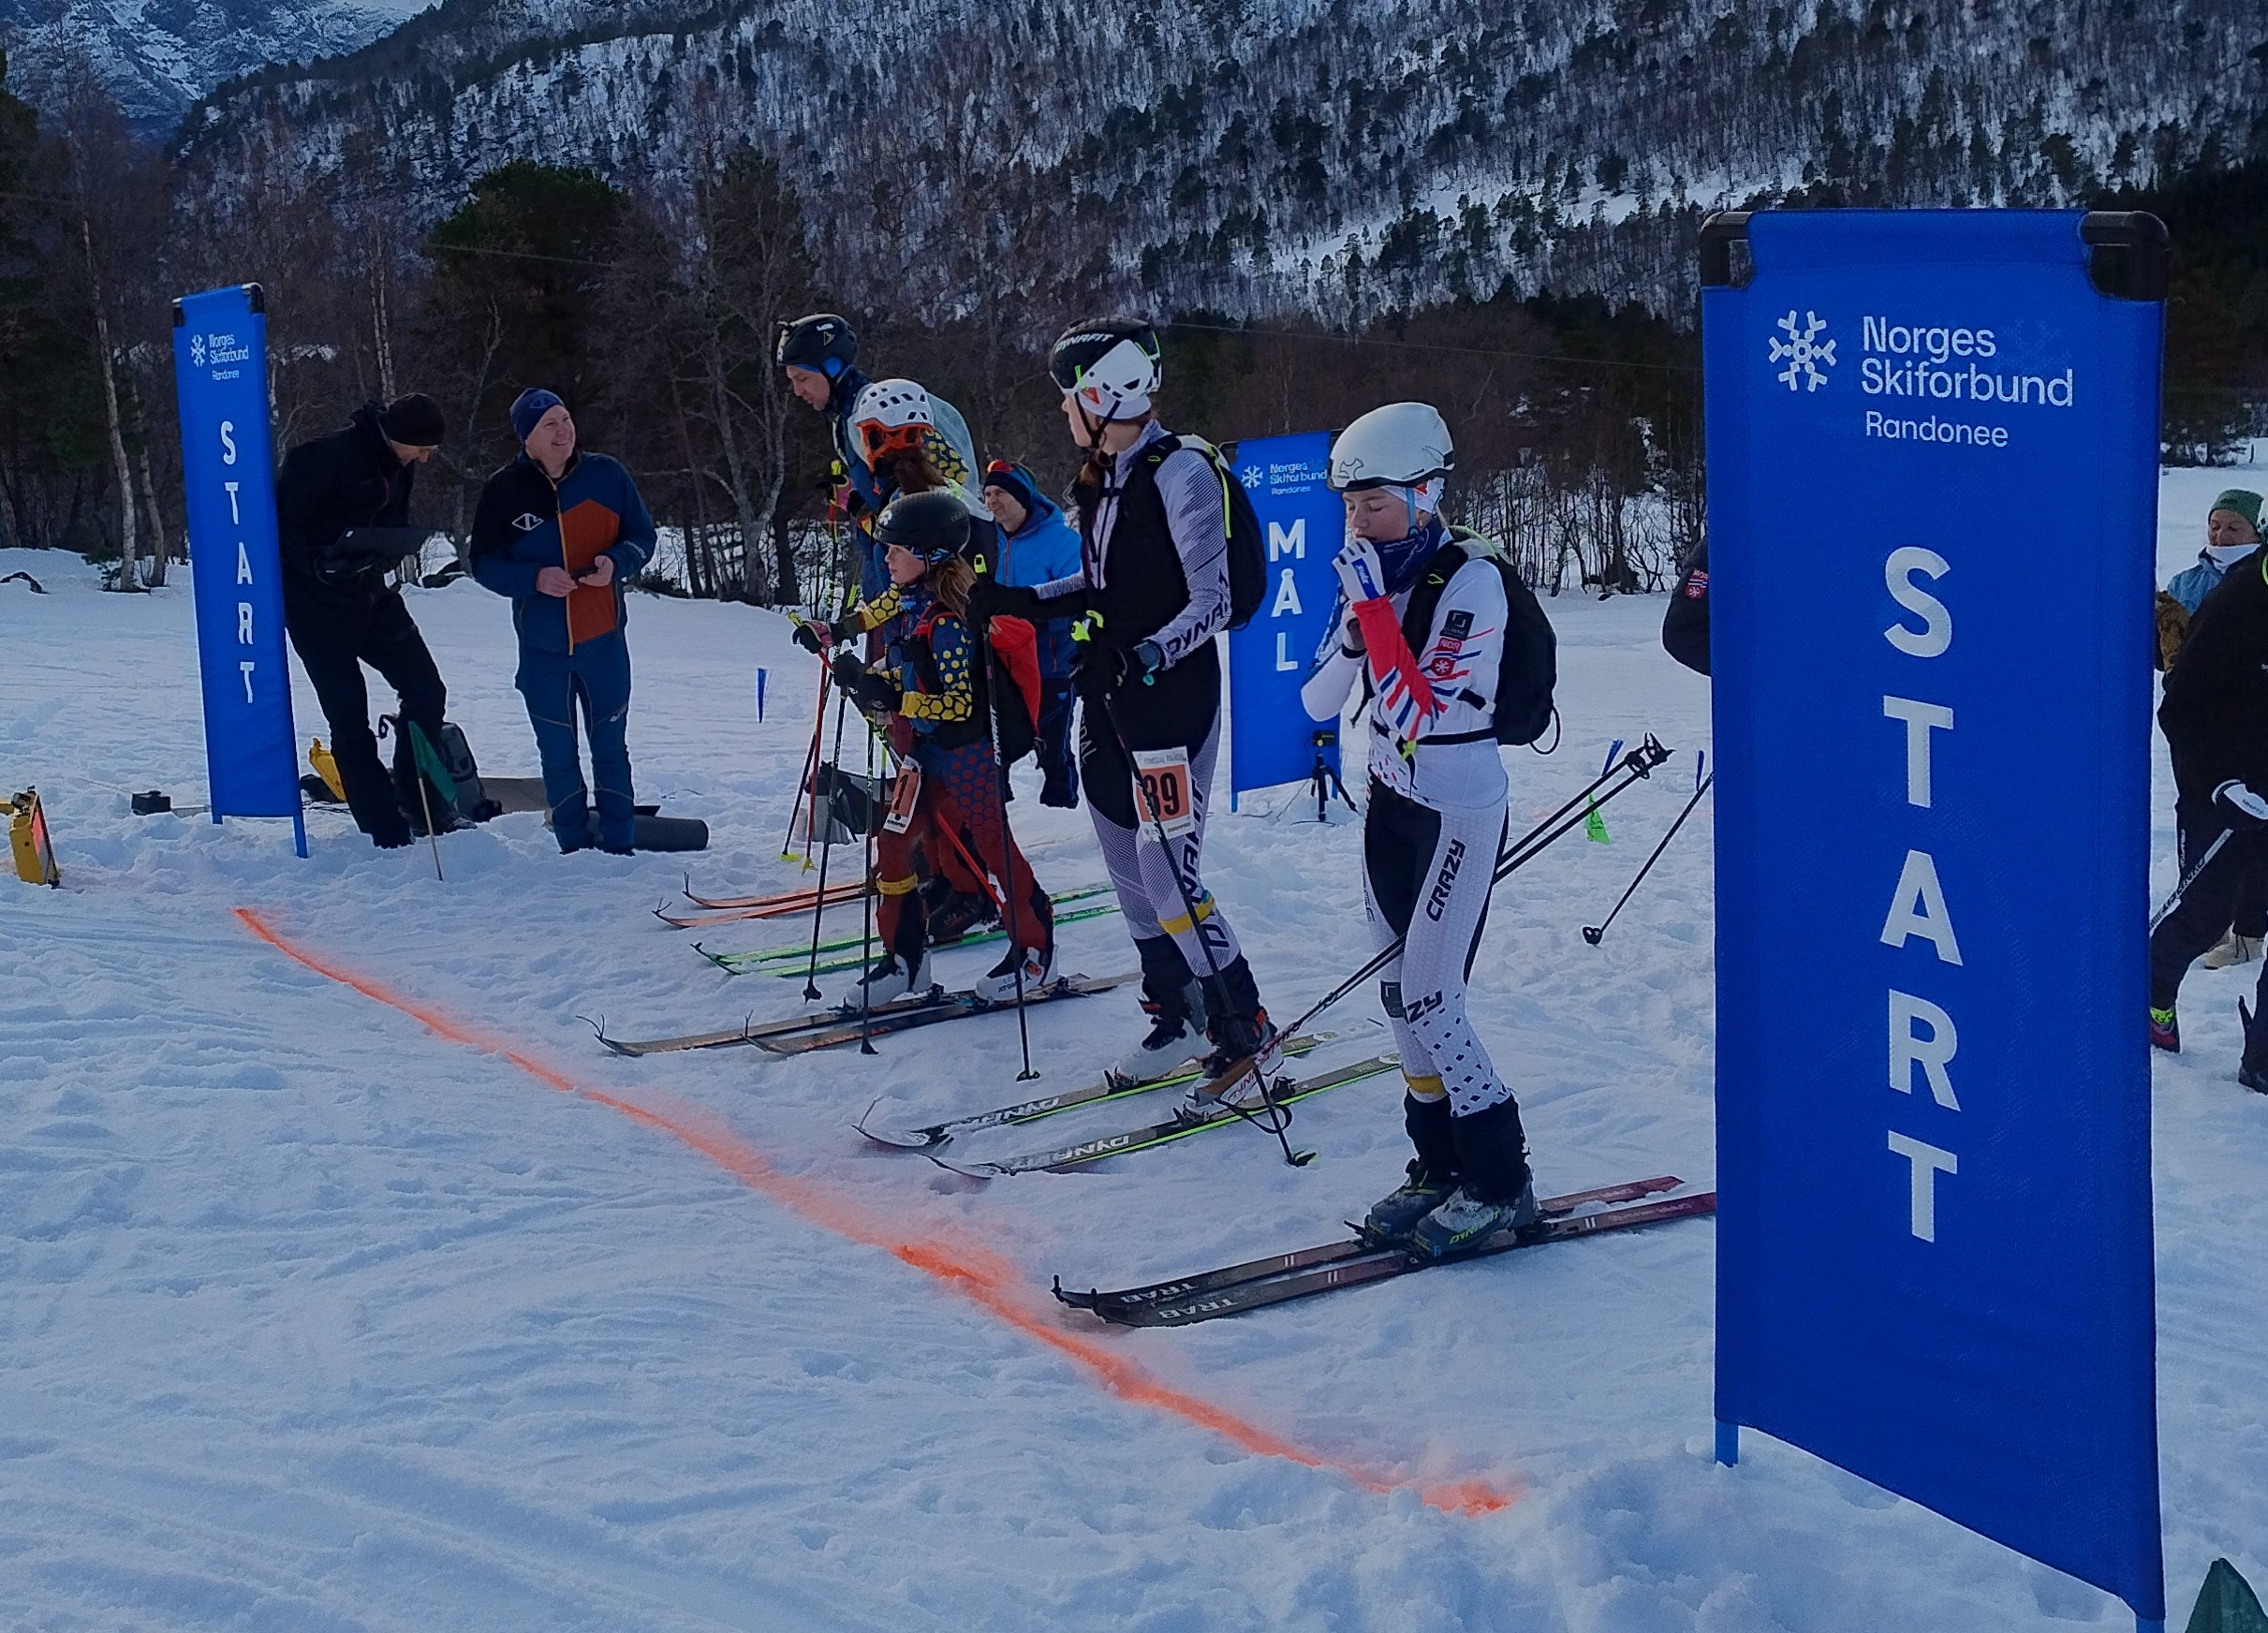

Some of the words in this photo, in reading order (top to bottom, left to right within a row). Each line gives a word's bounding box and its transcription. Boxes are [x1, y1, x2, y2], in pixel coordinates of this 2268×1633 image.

[1054, 332, 1114, 355] DYNAFIT
[1863, 316, 1997, 364] Norges
[1861, 358, 2074, 407] Skiforbund
[1865, 409, 2010, 448] Randonee
[1269, 462, 1308, 475] Norges
[1269, 468, 1328, 485] Skiforbund
[220, 419, 256, 704] START
[1268, 518, 1306, 672] MÅL
[1440, 638, 1462, 653] NOR
[989, 703, 1002, 767] DYNAFIT
[1425, 838, 1466, 922] CRAZY
[1879, 545, 1965, 1245] START
[1404, 989, 1444, 1025] ZY
[1120, 1282, 1200, 1304] TRAB
[1158, 1298, 1239, 1319] TRAB
